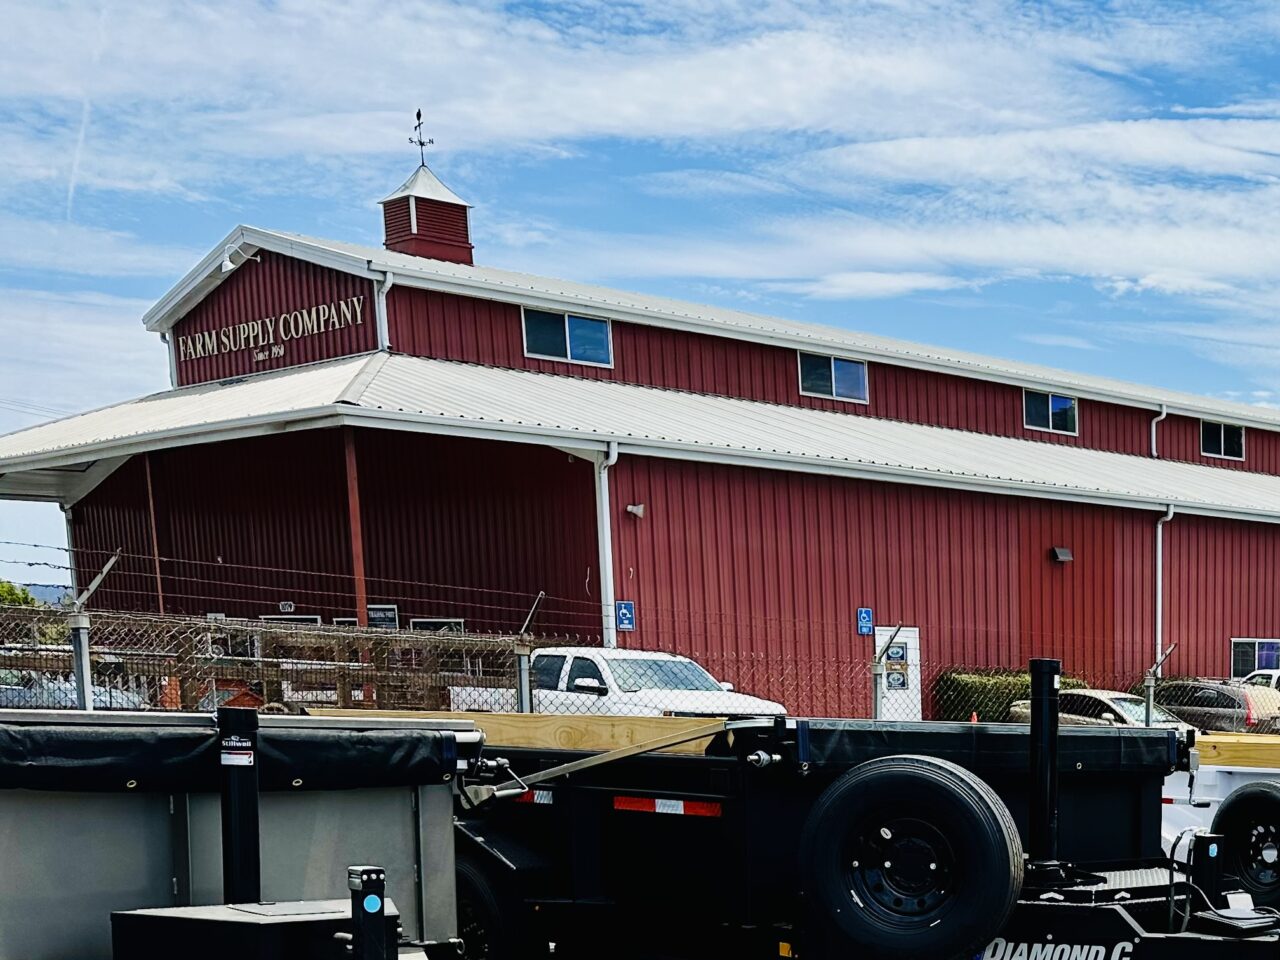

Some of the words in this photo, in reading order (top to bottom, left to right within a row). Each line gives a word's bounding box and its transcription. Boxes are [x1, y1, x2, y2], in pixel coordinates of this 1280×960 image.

[178, 329, 218, 362] FARM
[220, 316, 276, 353] SUPPLY
[279, 296, 364, 341] COMPANY
[253, 349, 269, 361] Since
